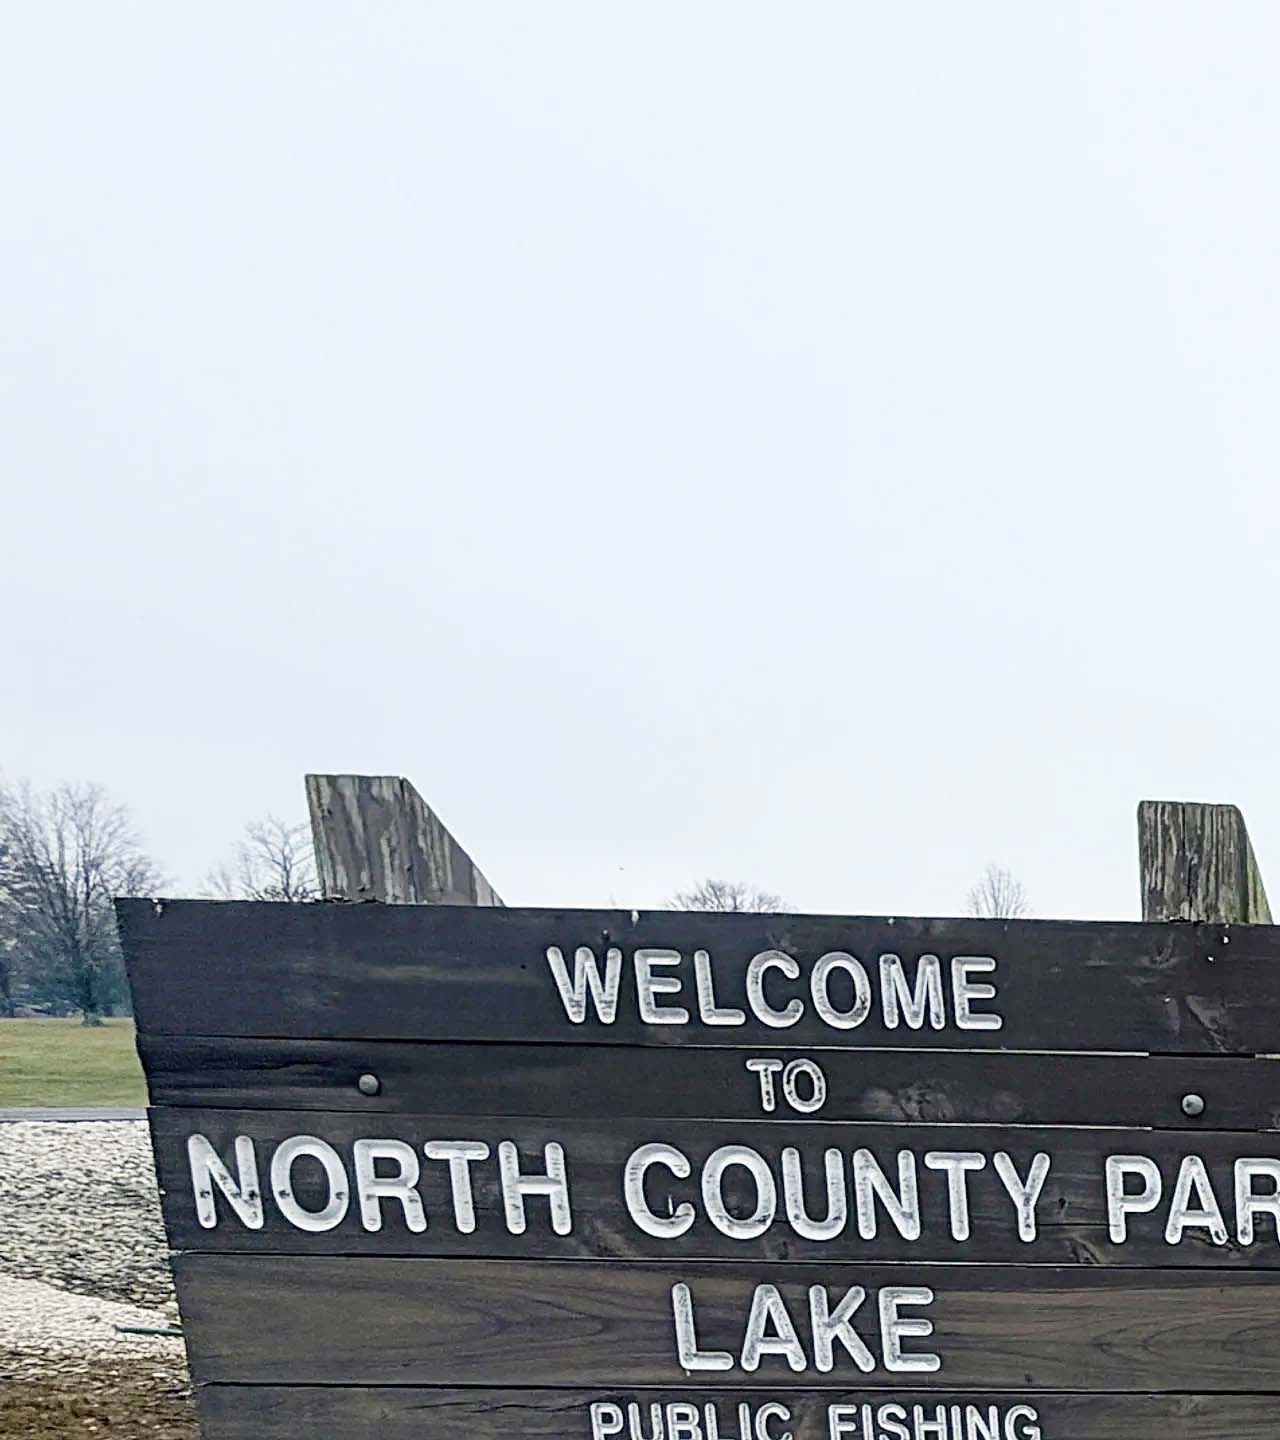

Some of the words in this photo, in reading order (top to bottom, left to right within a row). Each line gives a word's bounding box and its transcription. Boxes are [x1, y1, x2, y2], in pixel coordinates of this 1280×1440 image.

[546, 946, 1003, 1031] WELCOME
[745, 1057, 828, 1113] TO
[187, 1133, 573, 1237] NORTH
[623, 1141, 1051, 1243] COUNTY
[671, 1282, 942, 1374] LAKE
